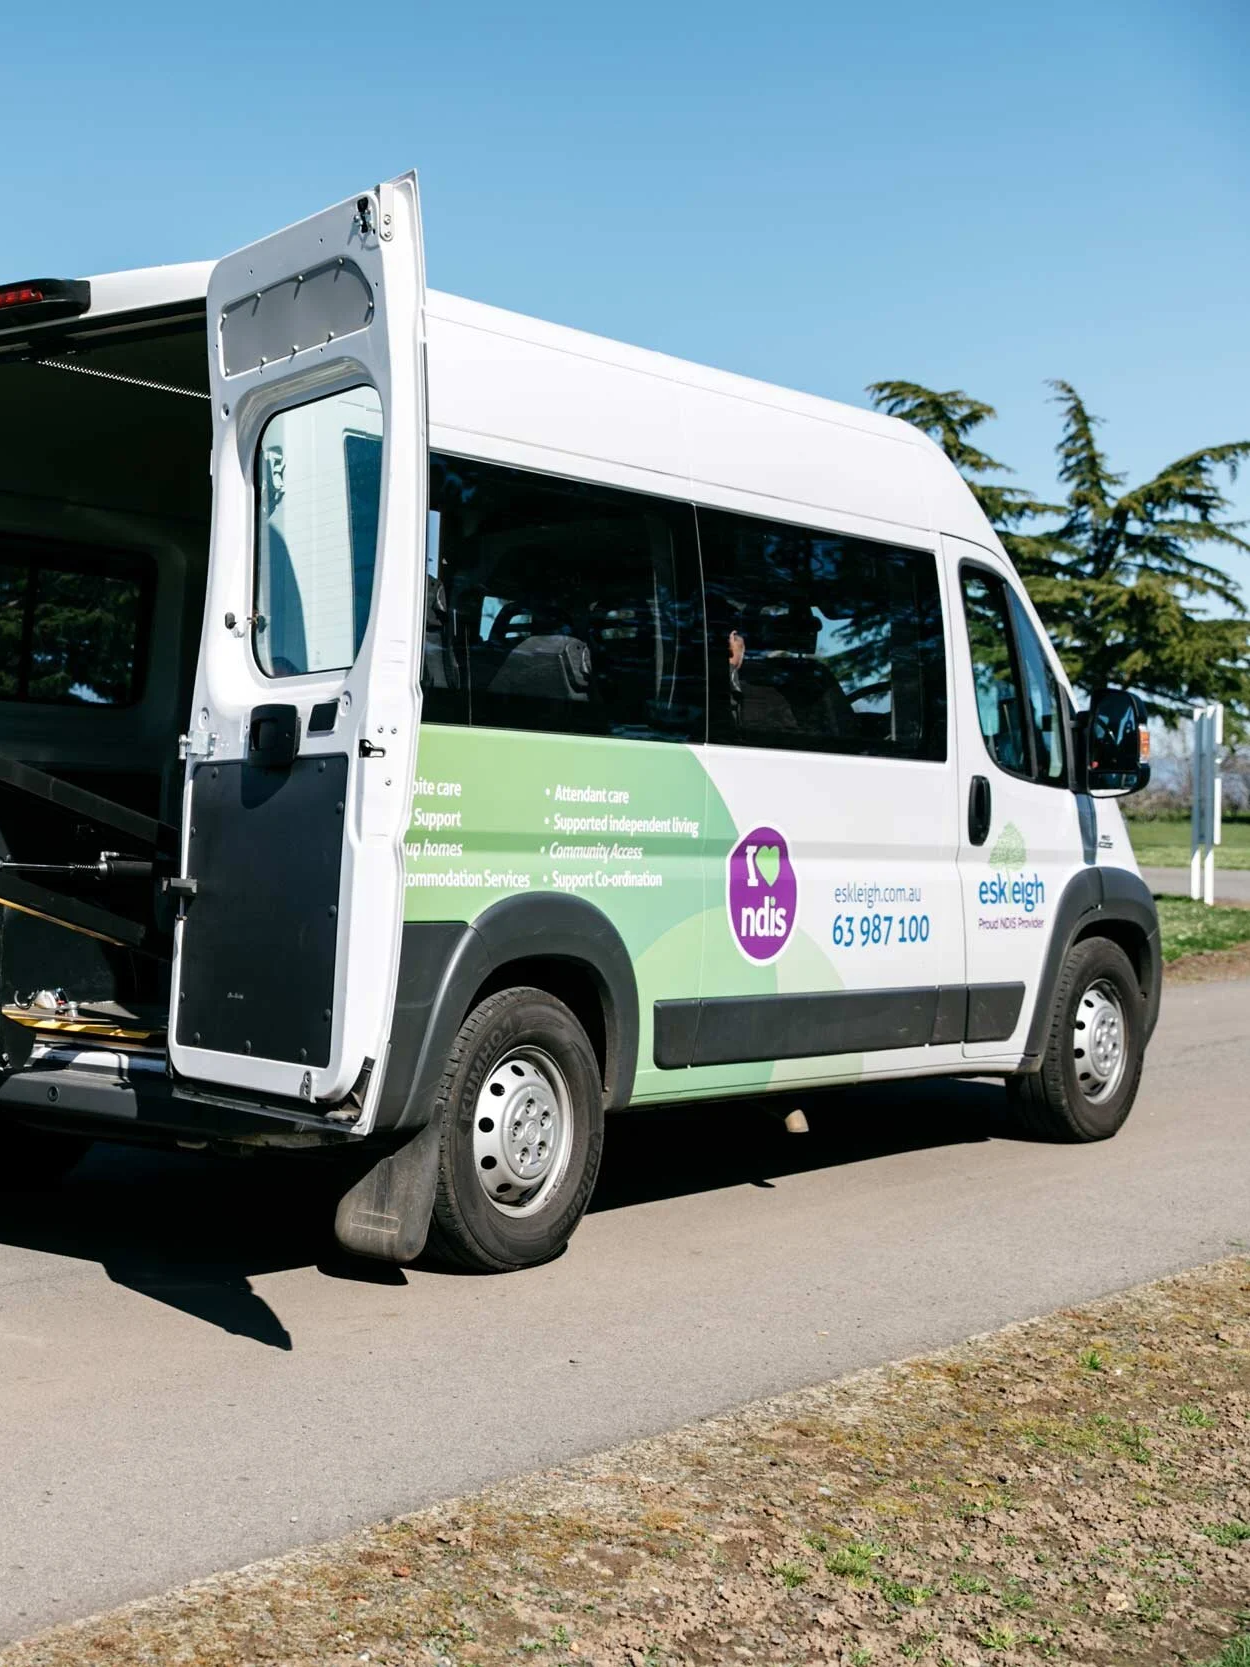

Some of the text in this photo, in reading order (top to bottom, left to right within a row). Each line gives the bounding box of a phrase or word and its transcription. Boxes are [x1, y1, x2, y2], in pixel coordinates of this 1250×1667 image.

[436, 782, 462, 797] care
[554, 784, 630, 804] Attendant care
[413, 807, 462, 832] Support
[553, 812, 699, 838] Supported independent living
[405, 838, 463, 862] up homes
[550, 841, 644, 864] Community Access
[745, 845, 759, 887] I
[484, 869, 530, 888] Services
[552, 870, 663, 893] Support Co-ordination
[834, 881, 922, 909] eskleigh.com.au
[741, 896, 787, 937] ndis
[978, 917, 998, 929] Proud
[1017, 917, 1044, 929] Provider
[833, 914, 930, 947] 63 987 100
